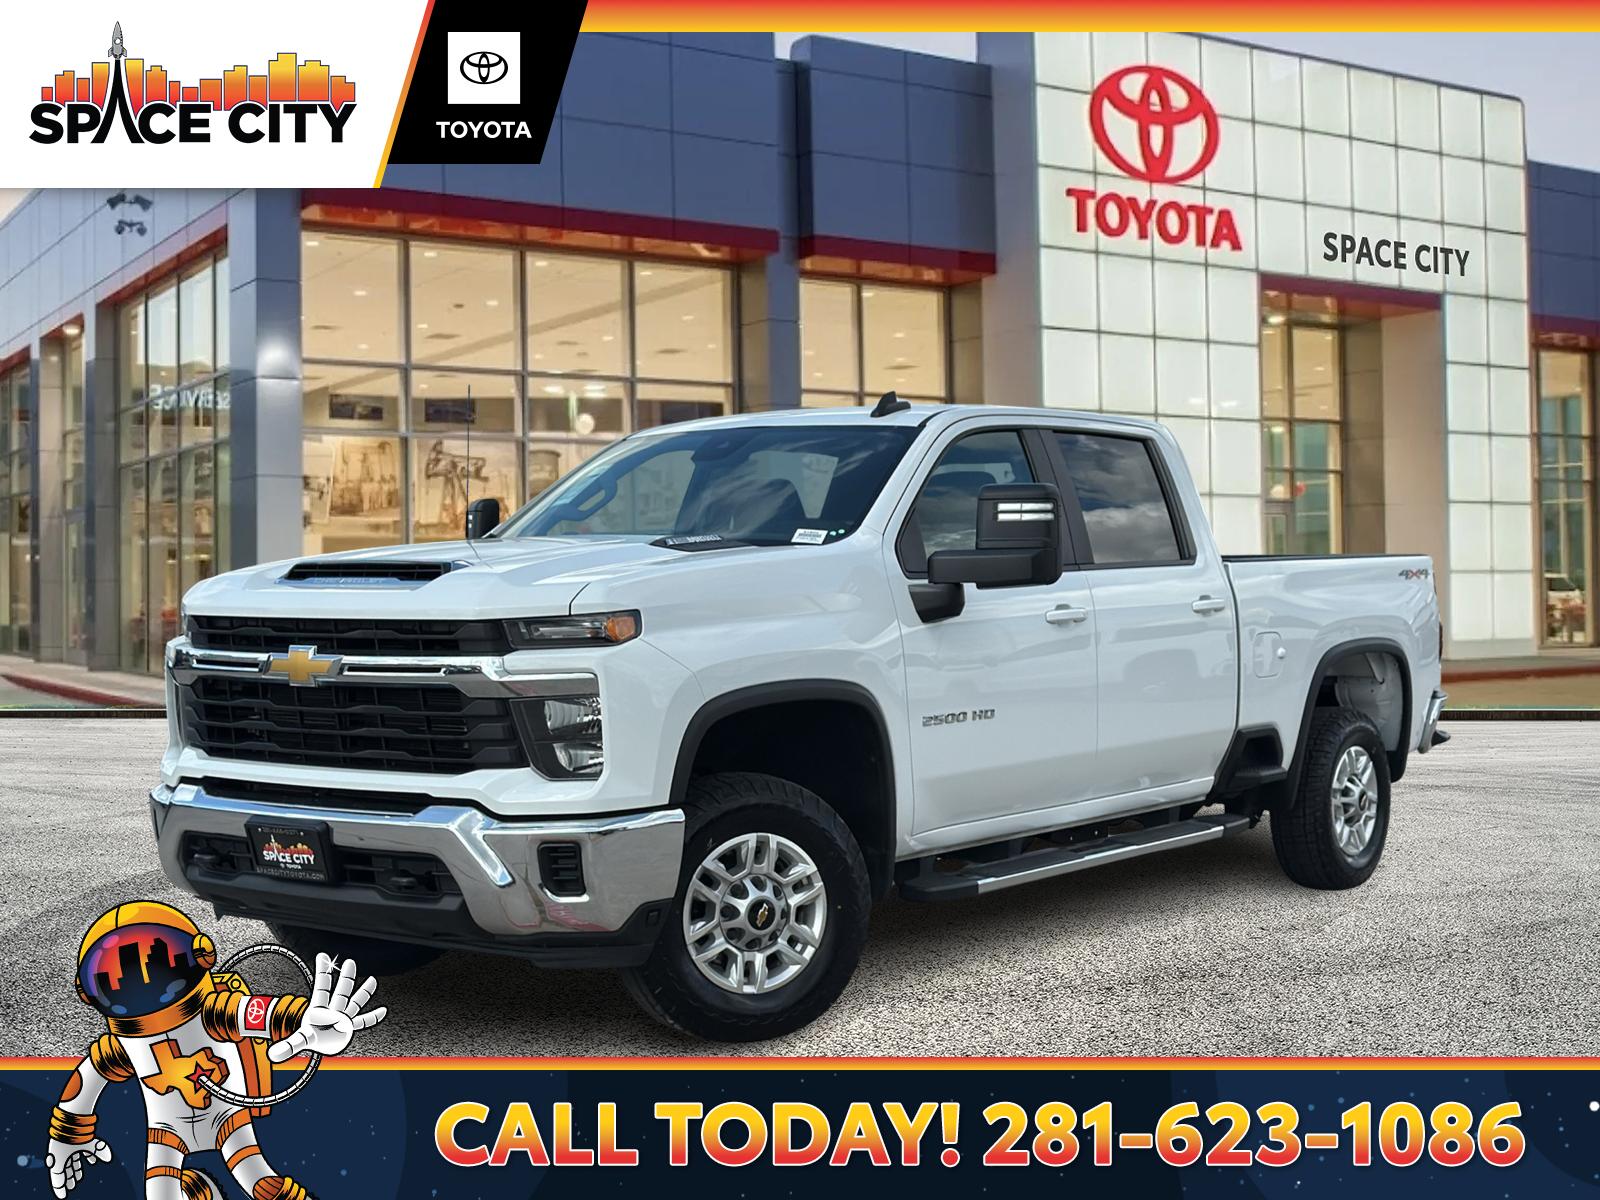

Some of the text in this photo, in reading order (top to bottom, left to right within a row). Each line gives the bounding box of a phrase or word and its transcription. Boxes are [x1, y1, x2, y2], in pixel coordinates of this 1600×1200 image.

[1066, 188, 1242, 252] TOYOTA
[1323, 231, 1470, 277] SPACE CITY
[922, 708, 995, 727] 2500 HD
[263, 850, 315, 865] SPACE CITY
